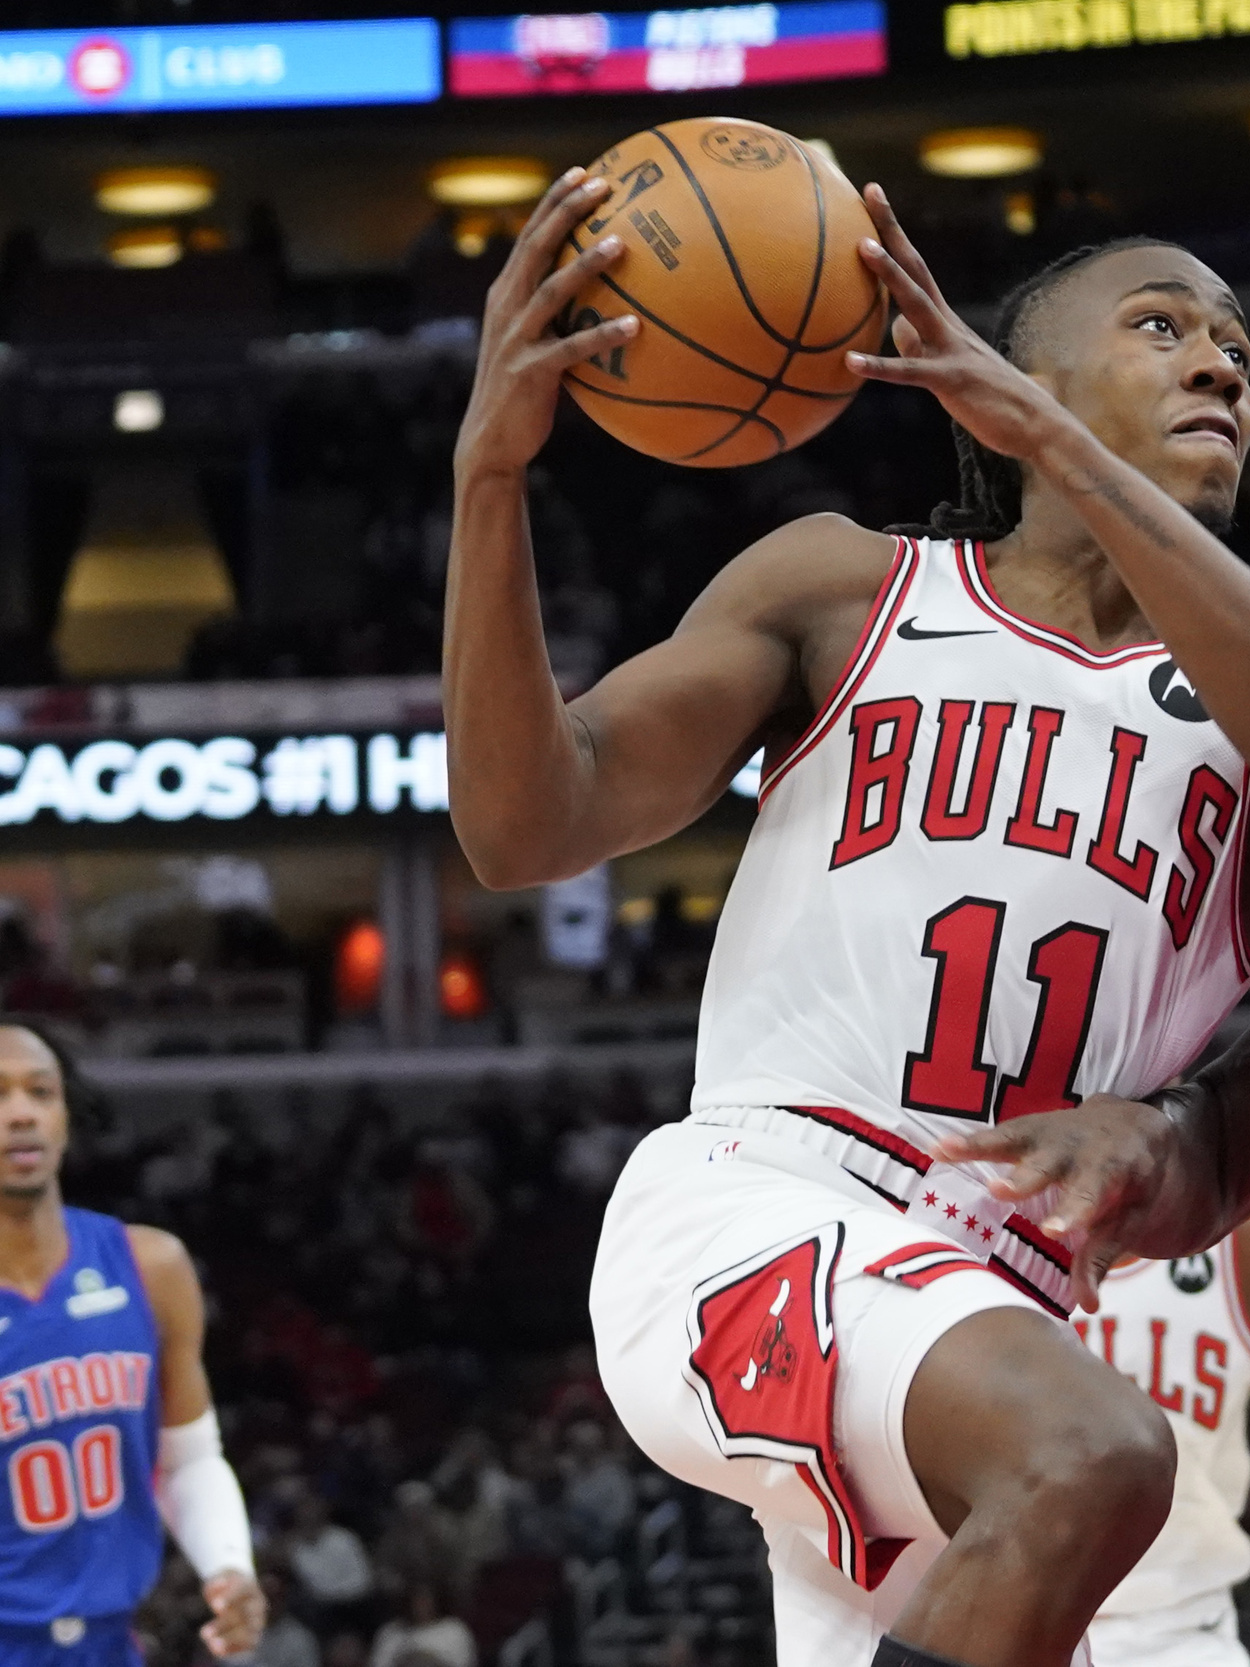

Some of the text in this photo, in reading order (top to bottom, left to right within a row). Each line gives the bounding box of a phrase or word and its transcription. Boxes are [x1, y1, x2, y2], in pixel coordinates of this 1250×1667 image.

[262, 733, 358, 816] #1
[829, 696, 1239, 951] BULLS
[901, 896, 1110, 1124] 11
[8, 1424, 125, 1534] 00
